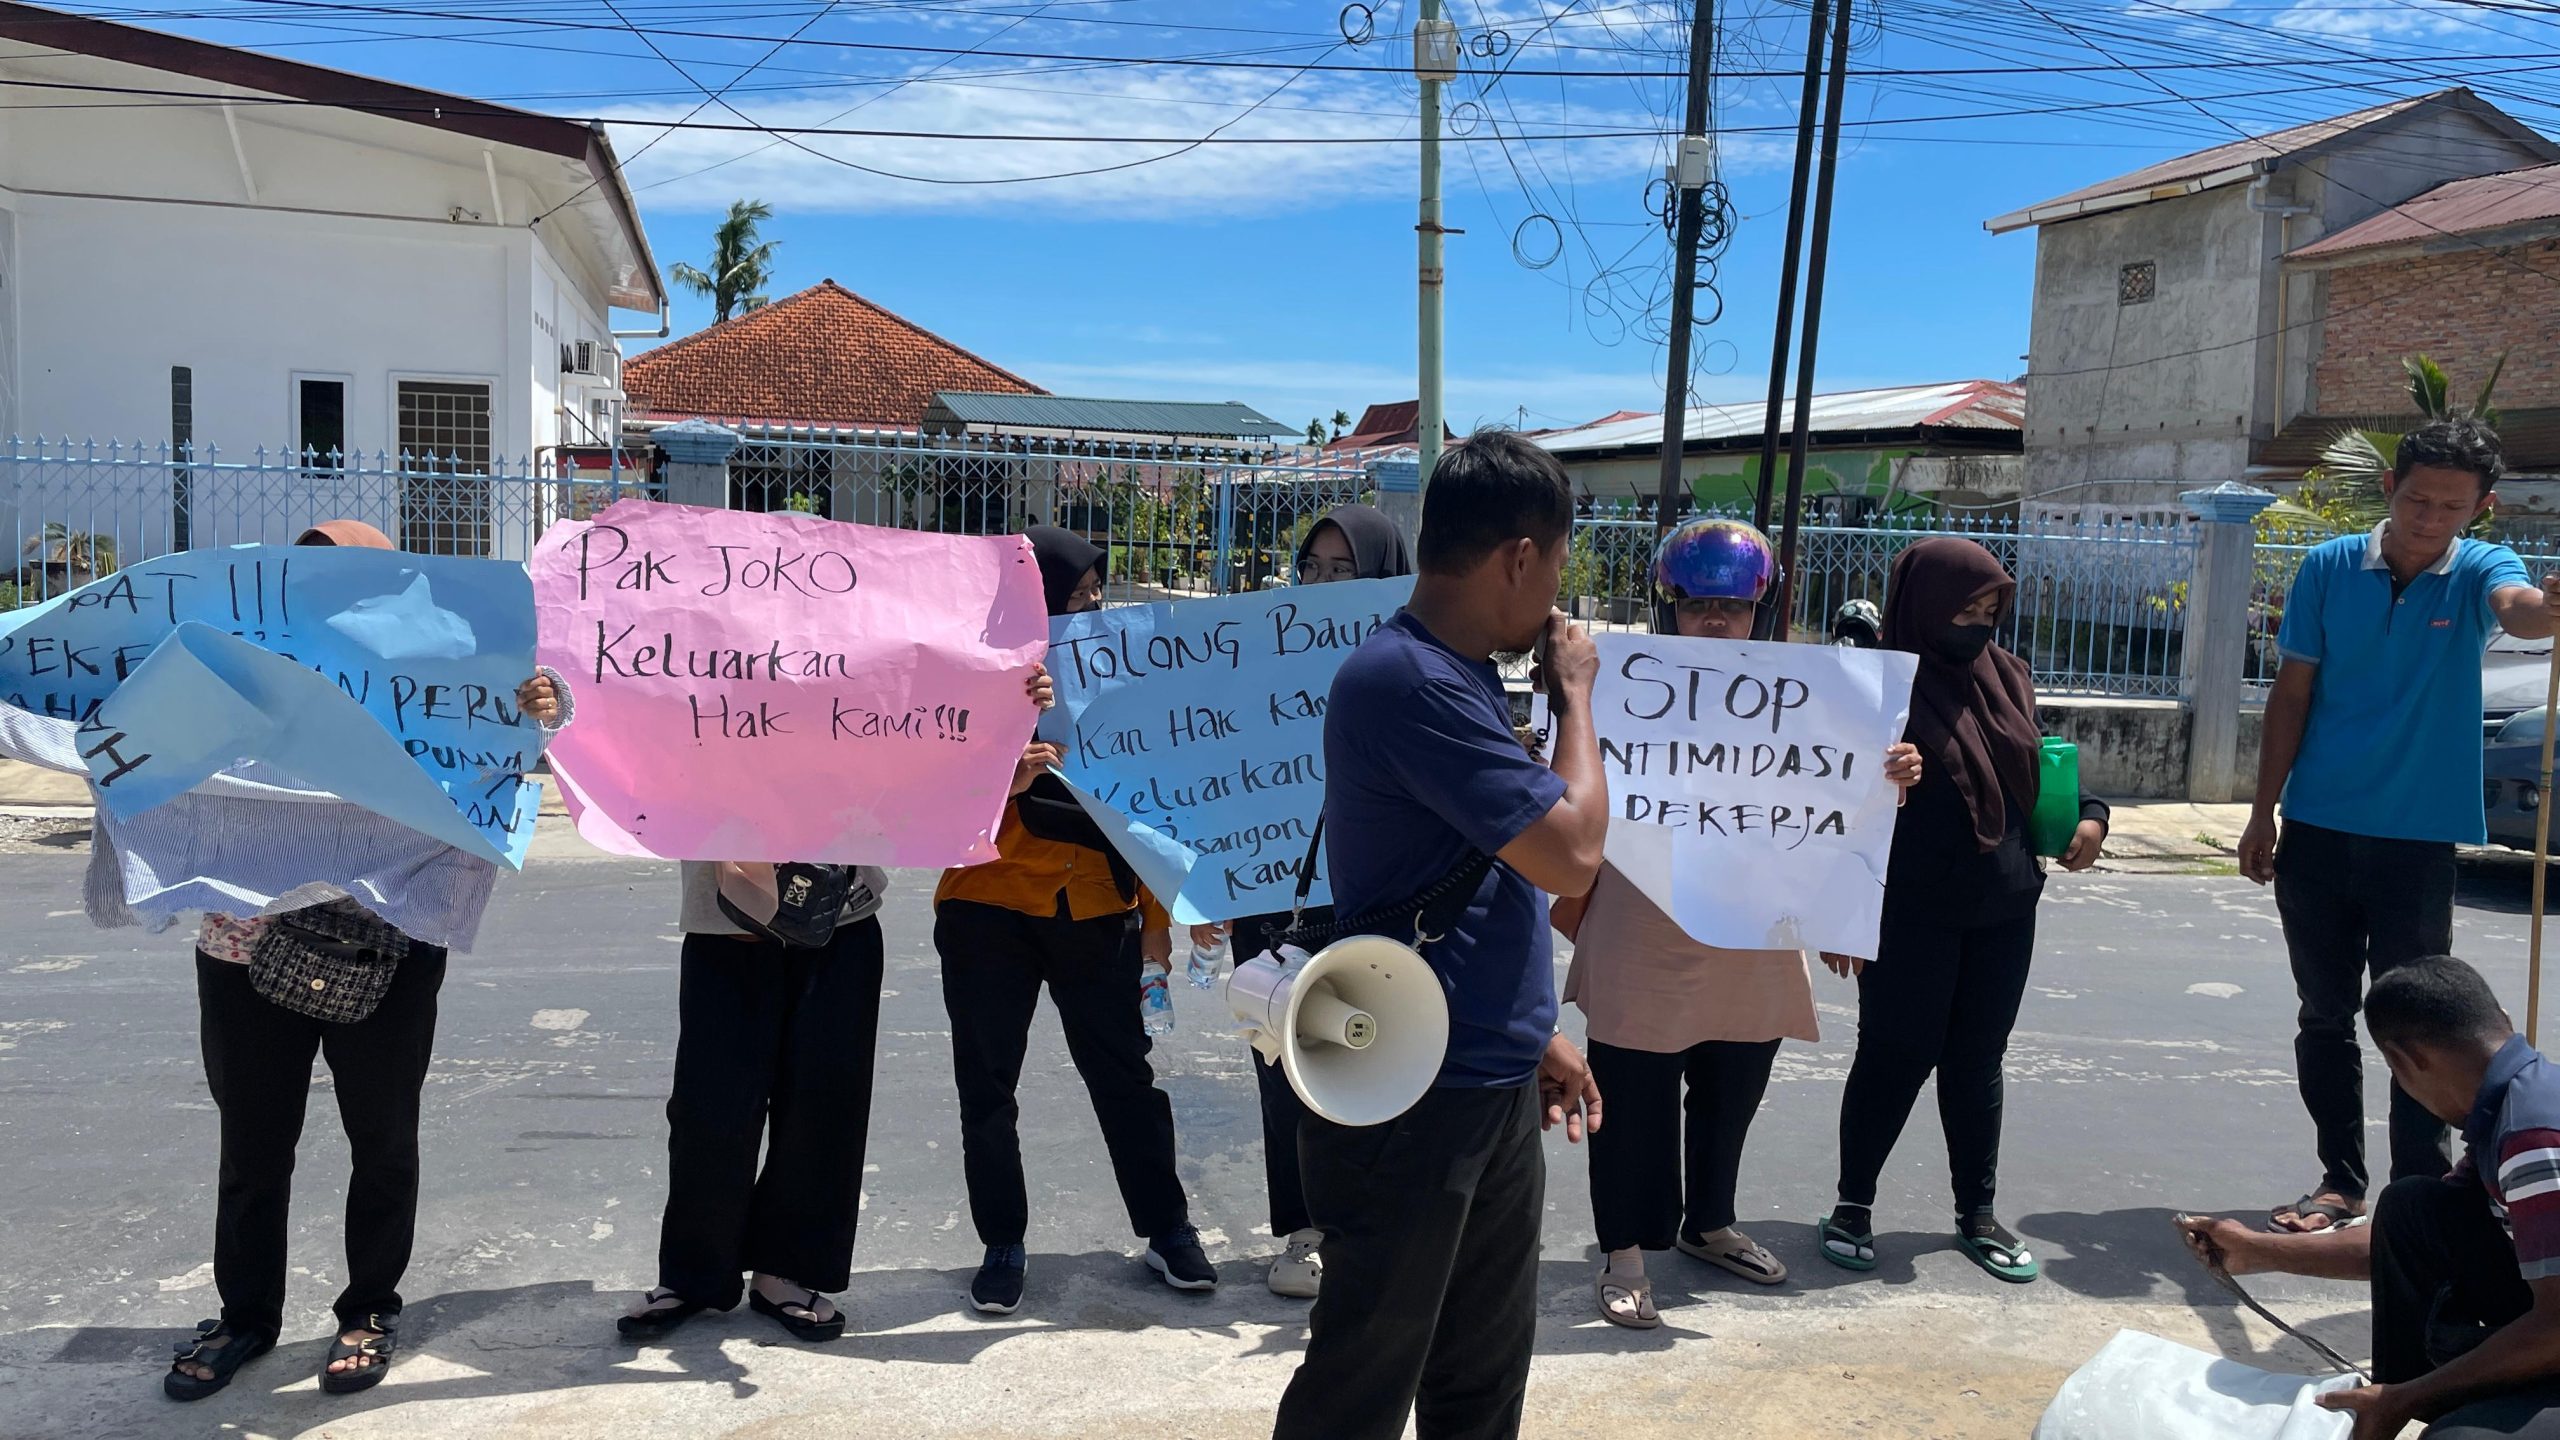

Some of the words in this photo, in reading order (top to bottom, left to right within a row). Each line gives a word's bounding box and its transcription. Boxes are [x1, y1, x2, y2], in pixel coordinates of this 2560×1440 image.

[561, 525, 679, 600] Pak
[596, 620, 856, 684] Keluarkan
[688, 694, 796, 739] Hak
[1621, 652, 1809, 734] STOP
[1076, 721, 1151, 769] Kan
[1169, 706, 1240, 747] Hak
